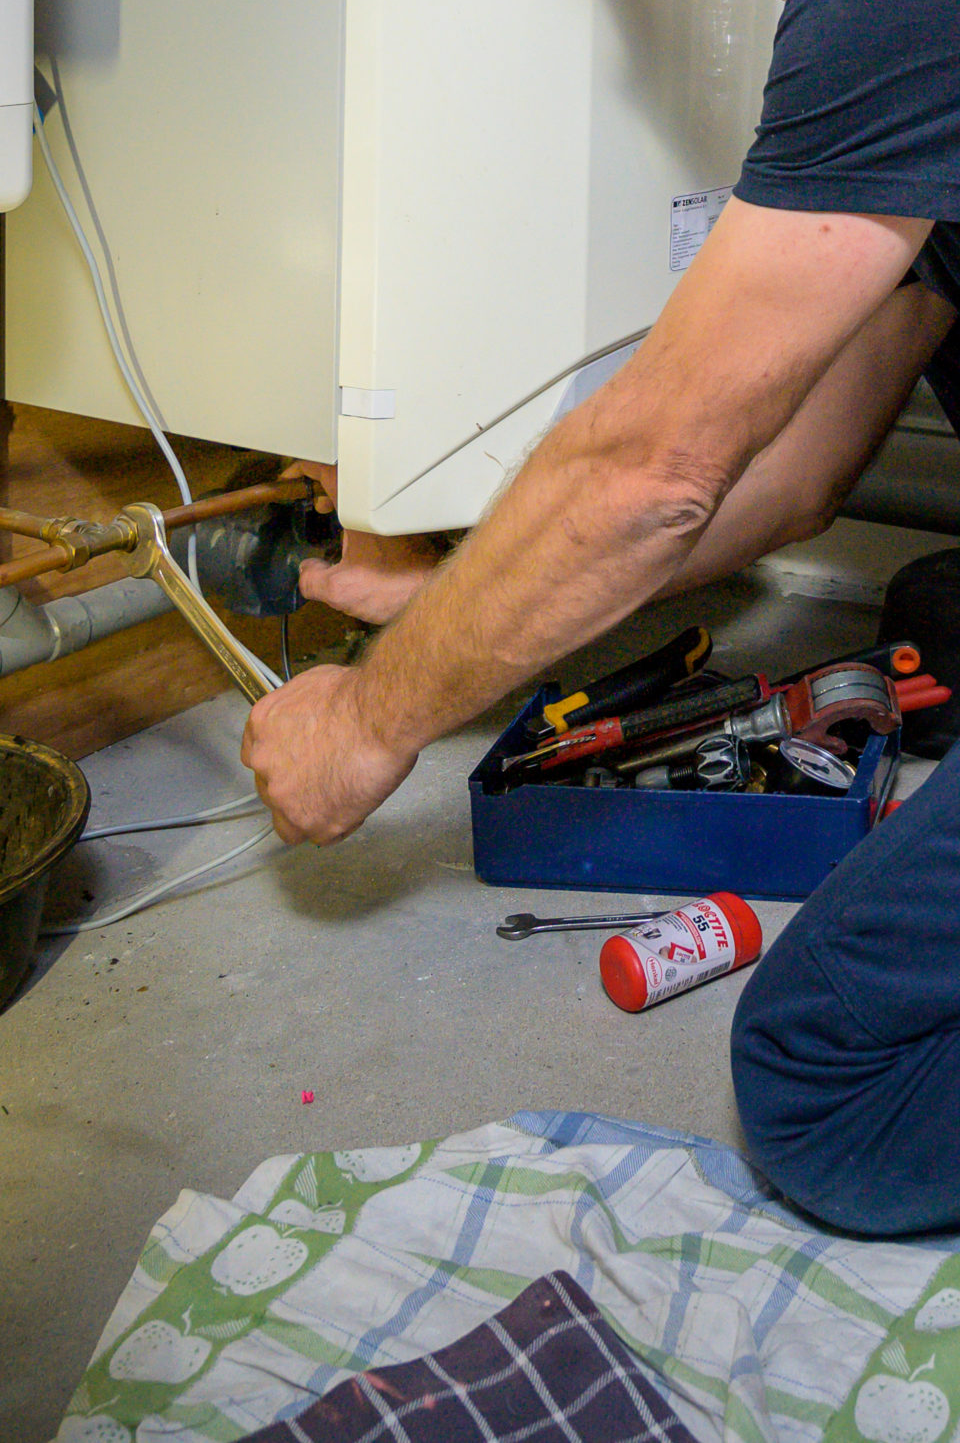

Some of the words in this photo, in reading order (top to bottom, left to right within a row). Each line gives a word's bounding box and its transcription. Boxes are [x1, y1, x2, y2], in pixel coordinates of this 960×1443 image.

[681, 195, 708, 208] ZENSOLAR
[691, 901, 729, 950] LOCTITE
[692, 914, 710, 932] 55
